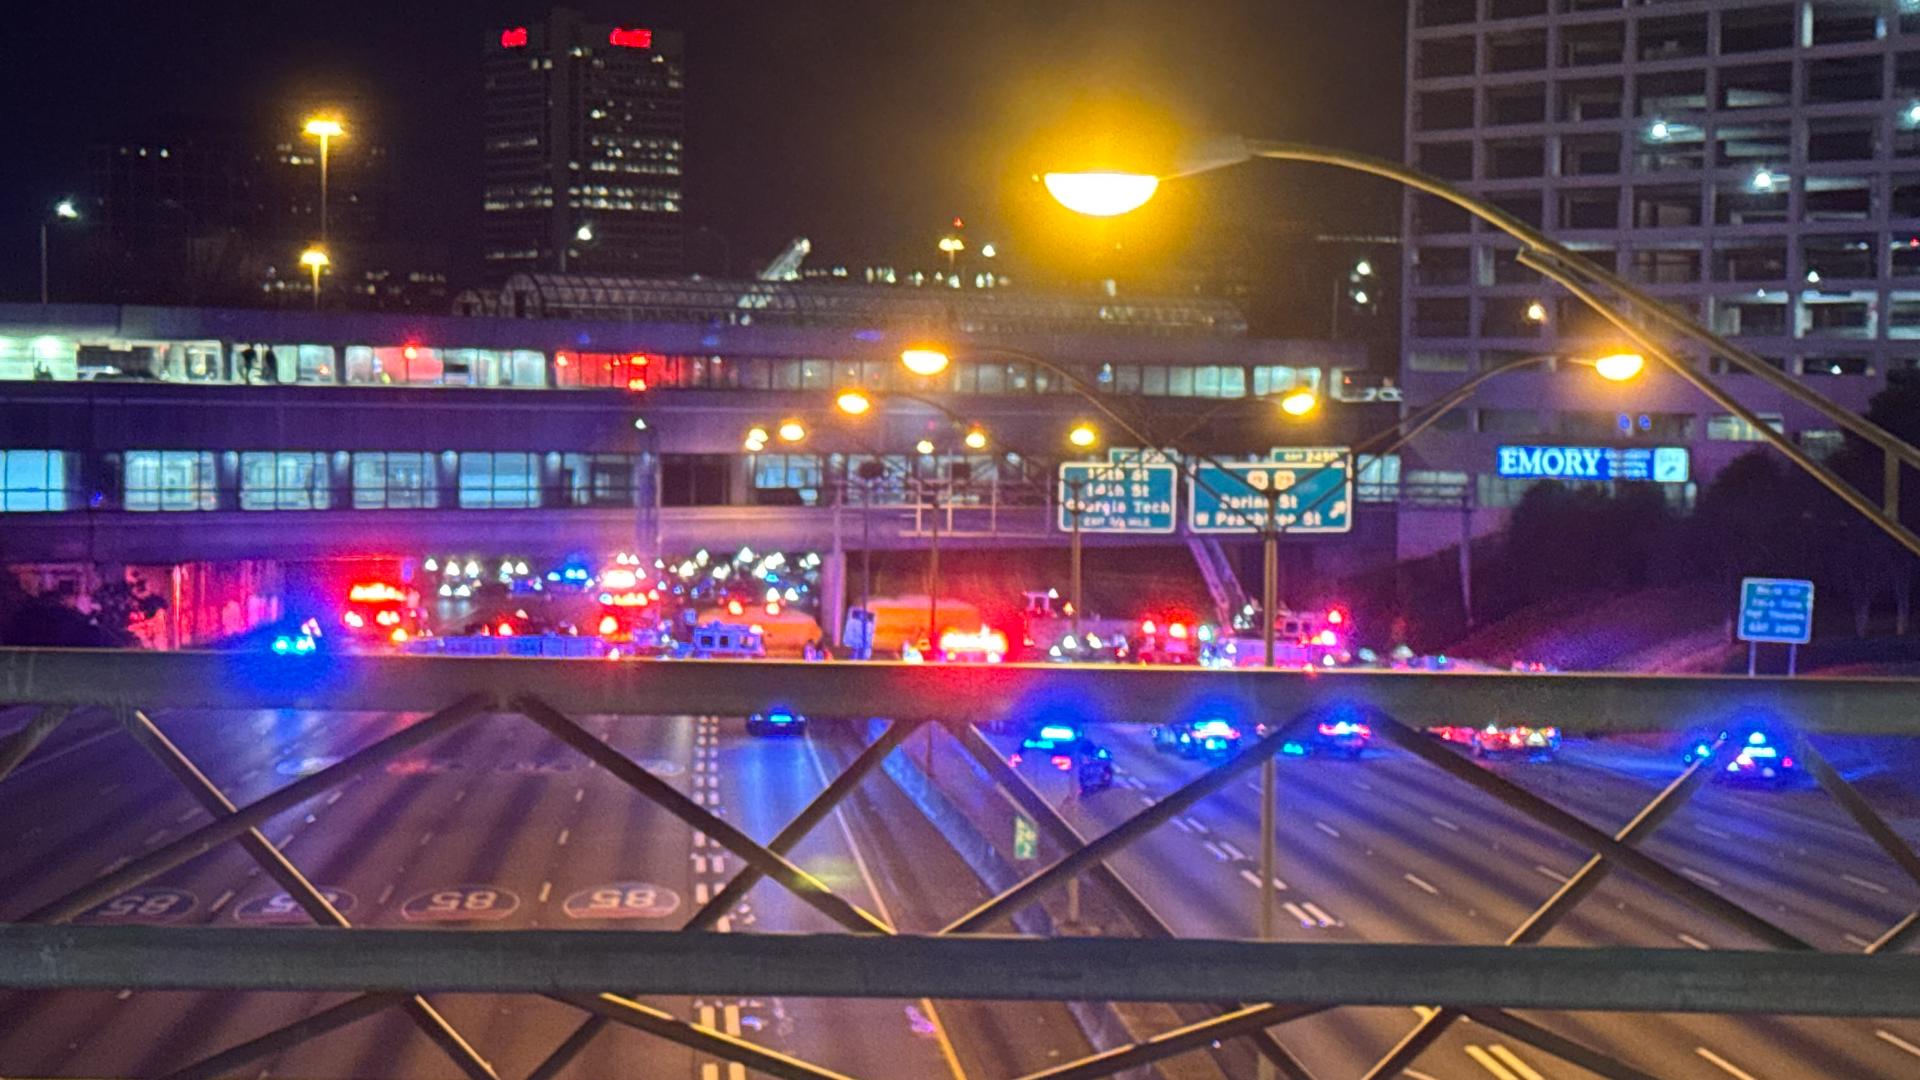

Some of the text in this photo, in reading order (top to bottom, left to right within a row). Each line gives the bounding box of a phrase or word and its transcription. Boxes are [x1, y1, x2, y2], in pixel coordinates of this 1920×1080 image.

[1500, 447, 1600, 476] EMORY
[1131, 483, 1149, 498] St
[1133, 501, 1170, 514] Tech
[1279, 493, 1298, 510] St
[1302, 511, 1322, 527] St
[427, 890, 497, 911] 85
[588, 888, 657, 909] 85
